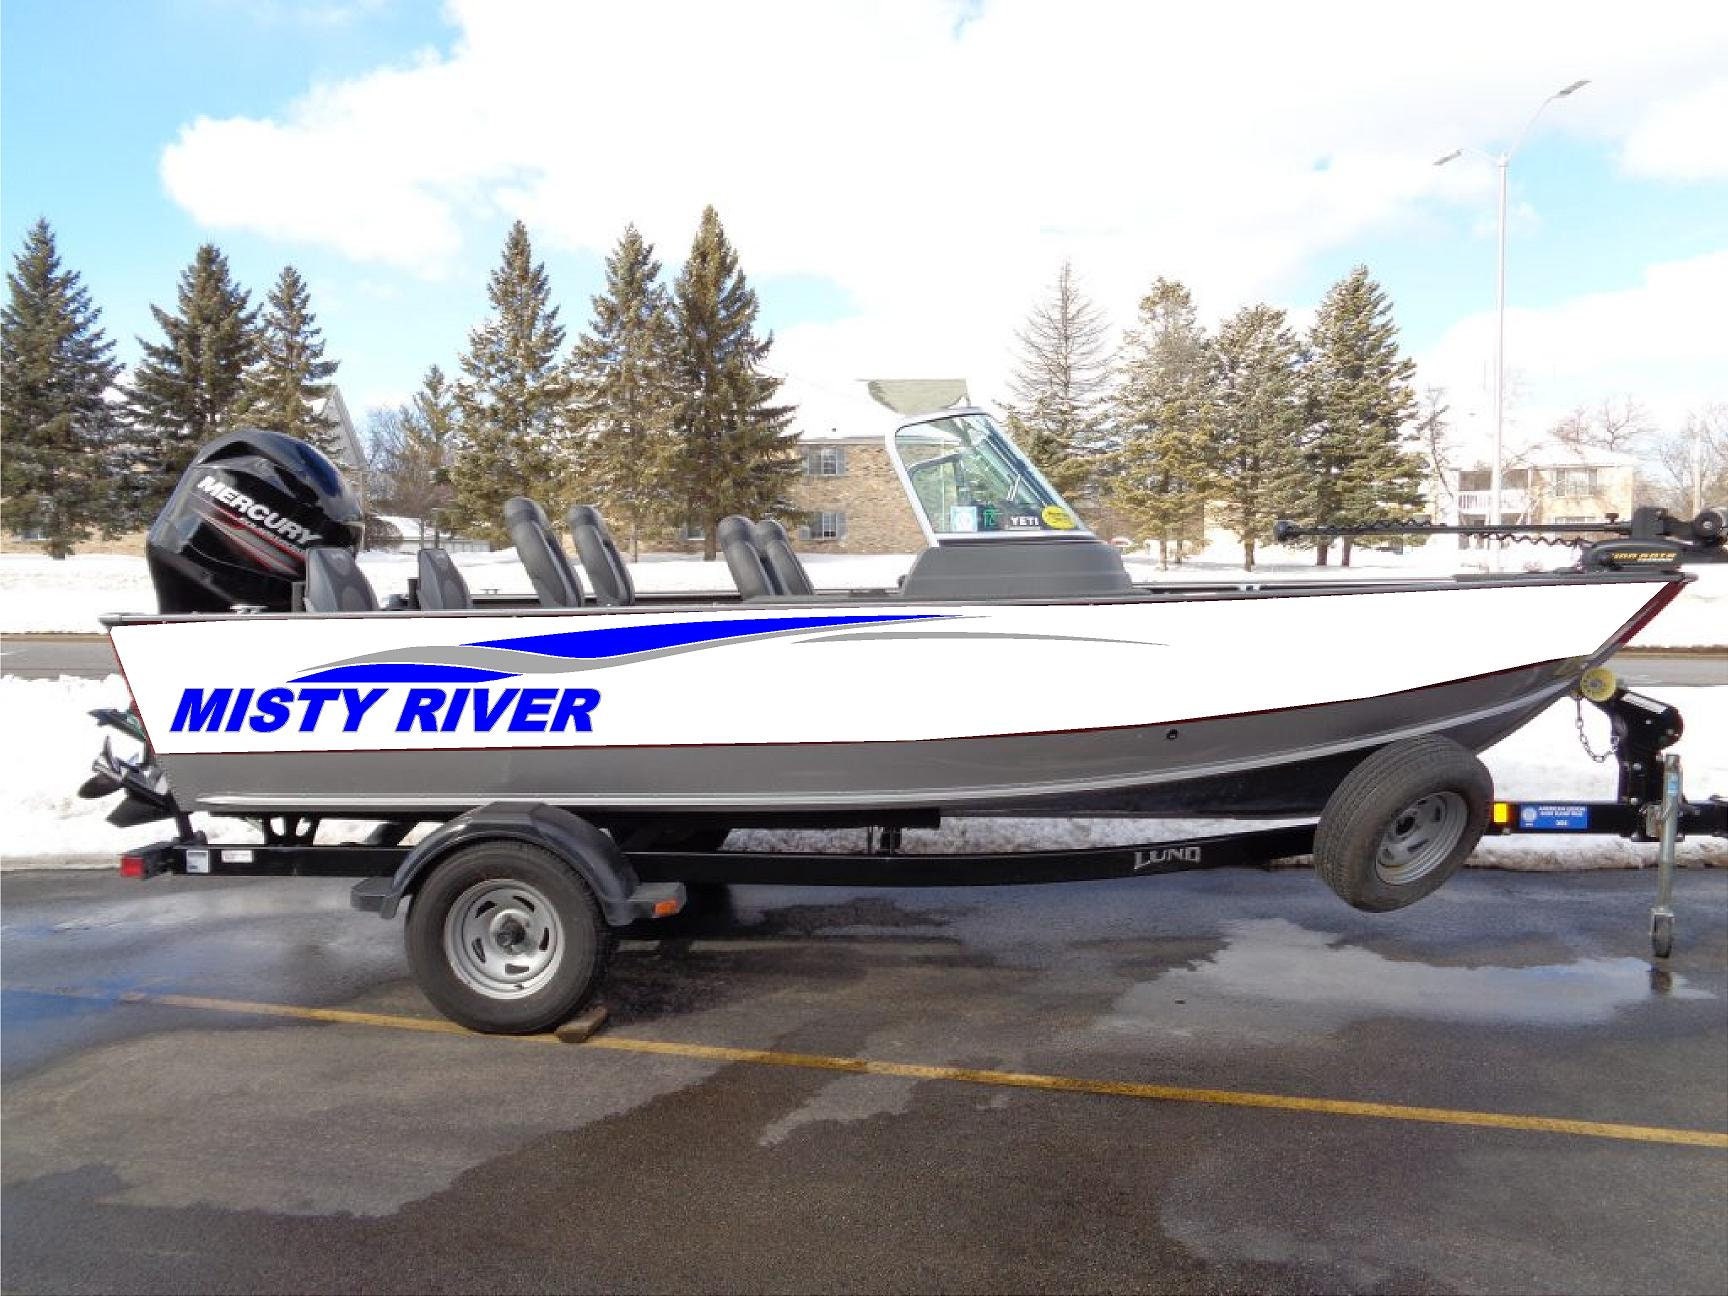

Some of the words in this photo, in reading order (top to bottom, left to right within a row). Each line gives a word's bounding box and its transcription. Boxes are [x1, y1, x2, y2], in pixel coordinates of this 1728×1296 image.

[198, 475, 323, 544] MERCURY
[1010, 516, 1040, 527] YETI
[170, 687, 387, 733] MISTY
[395, 687, 601, 733] RIVER
[1133, 846, 1201, 870] LUND
